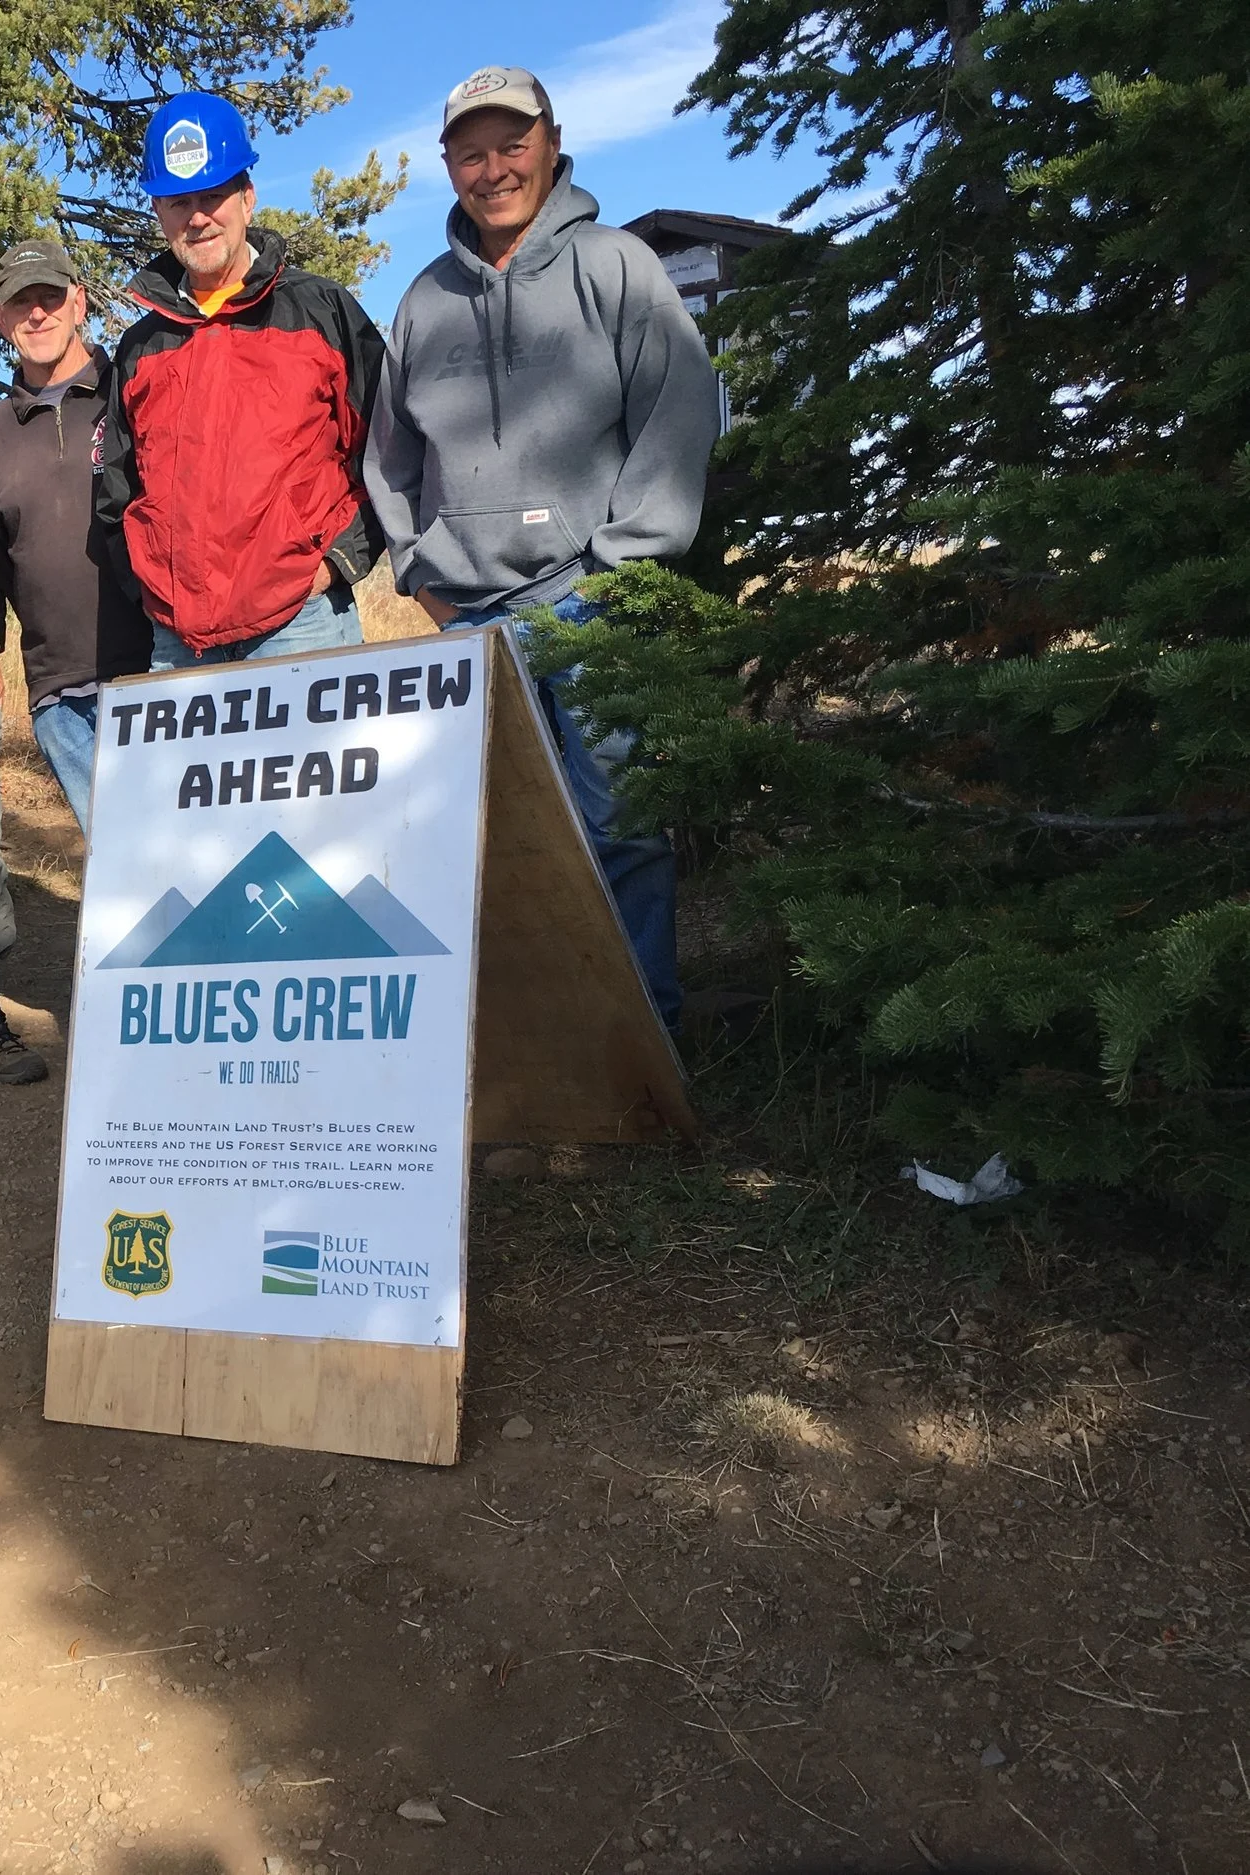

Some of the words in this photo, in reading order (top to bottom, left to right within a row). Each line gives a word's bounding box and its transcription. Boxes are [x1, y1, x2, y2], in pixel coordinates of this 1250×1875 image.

[167, 152, 187, 166] BLUES
[187, 150, 205, 161] CREW
[112, 686, 289, 746] TRAIL
[307, 658, 471, 723] CREW
[178, 747, 379, 809] AHEAD
[120, 979, 261, 1045] BLUES
[273, 974, 417, 1042] CREW
[219, 1061, 235, 1085] WE
[239, 1061, 255, 1084] DO
[261, 1060, 300, 1084] TRAILS
[106, 1121, 128, 1132] THE
[133, 1121, 164, 1132] BLUE
[168, 1122, 230, 1132] MOUNTAIN
[234, 1122, 267, 1132] LAND
[328, 1123, 371, 1133] BLUES
[376, 1123, 415, 1133] CREW
[86, 1140, 158, 1149] VOLUNTEERS
[162, 1141, 186, 1150] AND
[189, 1141, 212, 1150] THE
[216, 1140, 234, 1150] US
[239, 1141, 285, 1151] FOREST
[289, 1141, 343, 1152] SERVICE
[347, 1143, 372, 1152] ARE
[376, 1143, 438, 1153] WORKING
[87, 1157, 101, 1166] TO
[105, 1158, 154, 1167] IMPROVE
[157, 1158, 180, 1168] THE
[183, 1159, 248, 1169] CONDITION
[252, 1160, 268, 1169] OF
[272, 1160, 300, 1170] THIS
[304, 1161, 345, 1171] TRAIL.
[349, 1161, 392, 1172] LEARN
[397, 1163, 434, 1172] MORE
[109, 1175, 146, 1185] ABOUT
[149, 1176, 174, 1185] OUR
[178, 1177, 229, 1187] EFFORTS
[233, 1178, 248, 1187] AT
[252, 1178, 405, 1191] BMLT.ORG/BLUES-CREW.
[111, 1219, 138, 1234] FOREST
[139, 1219, 167, 1237] SERVICE
[323, 1234, 369, 1253] BLUE
[321, 1256, 430, 1278] MOUNTAIN
[106, 1265, 133, 1290] DEPARTMENT
[132, 1283, 141, 1291] OF
[140, 1267, 169, 1291] AGRICULTURE
[321, 1279, 369, 1297] LAND
[373, 1281, 431, 1300] TRUST
